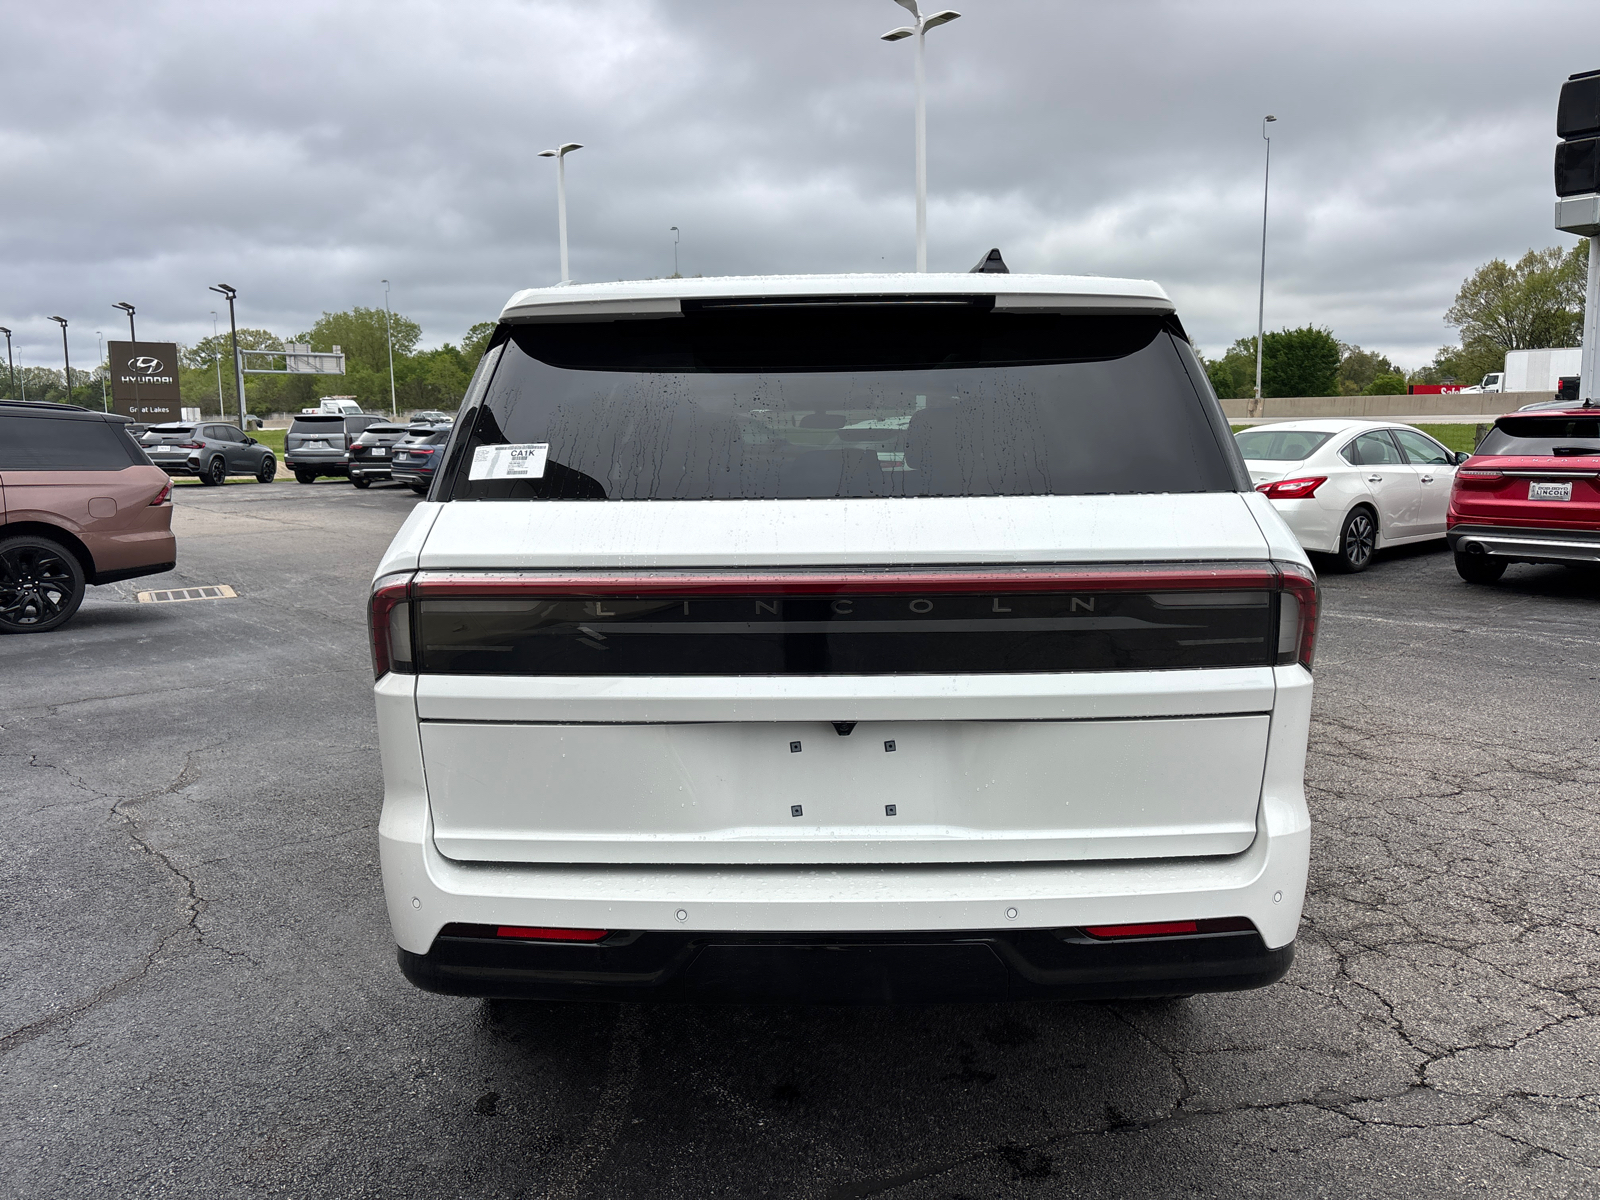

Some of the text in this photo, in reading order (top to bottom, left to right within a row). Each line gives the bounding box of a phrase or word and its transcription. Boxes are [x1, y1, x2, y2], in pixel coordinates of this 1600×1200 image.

[121, 376, 172, 384] HYUNDAI
[510, 449, 536, 457] CA1K
[596, 597, 1095, 616] LINCOLN
